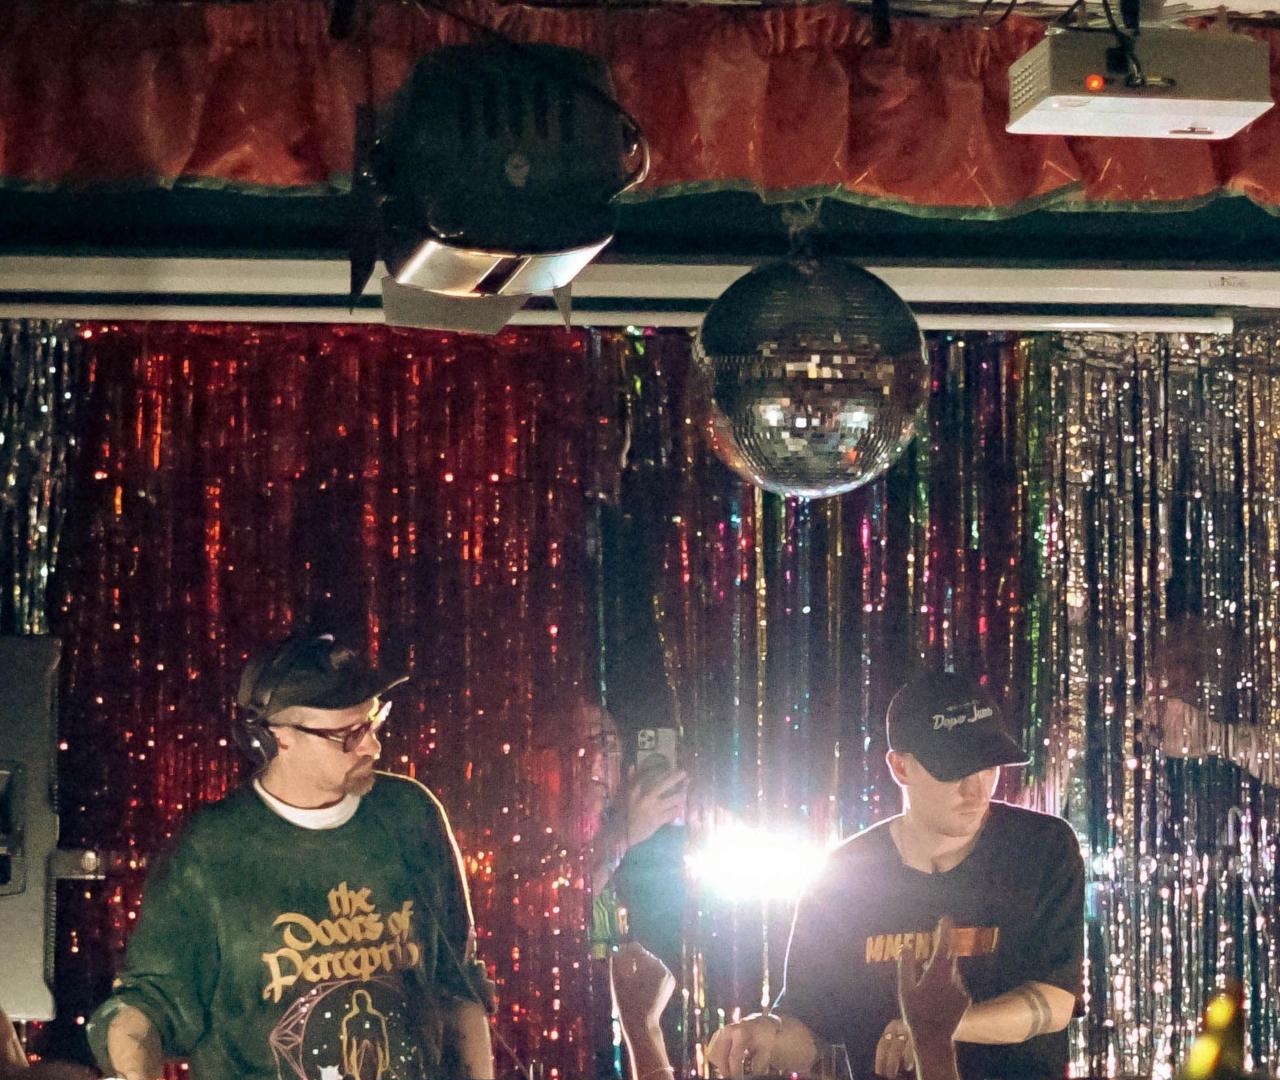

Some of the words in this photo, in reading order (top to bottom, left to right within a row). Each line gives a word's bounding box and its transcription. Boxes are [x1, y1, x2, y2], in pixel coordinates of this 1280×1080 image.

[272, 912, 384, 951] Doors
[387, 900, 414, 942] of
[327, 881, 376, 919] the
[261, 947, 420, 1004] Percept
